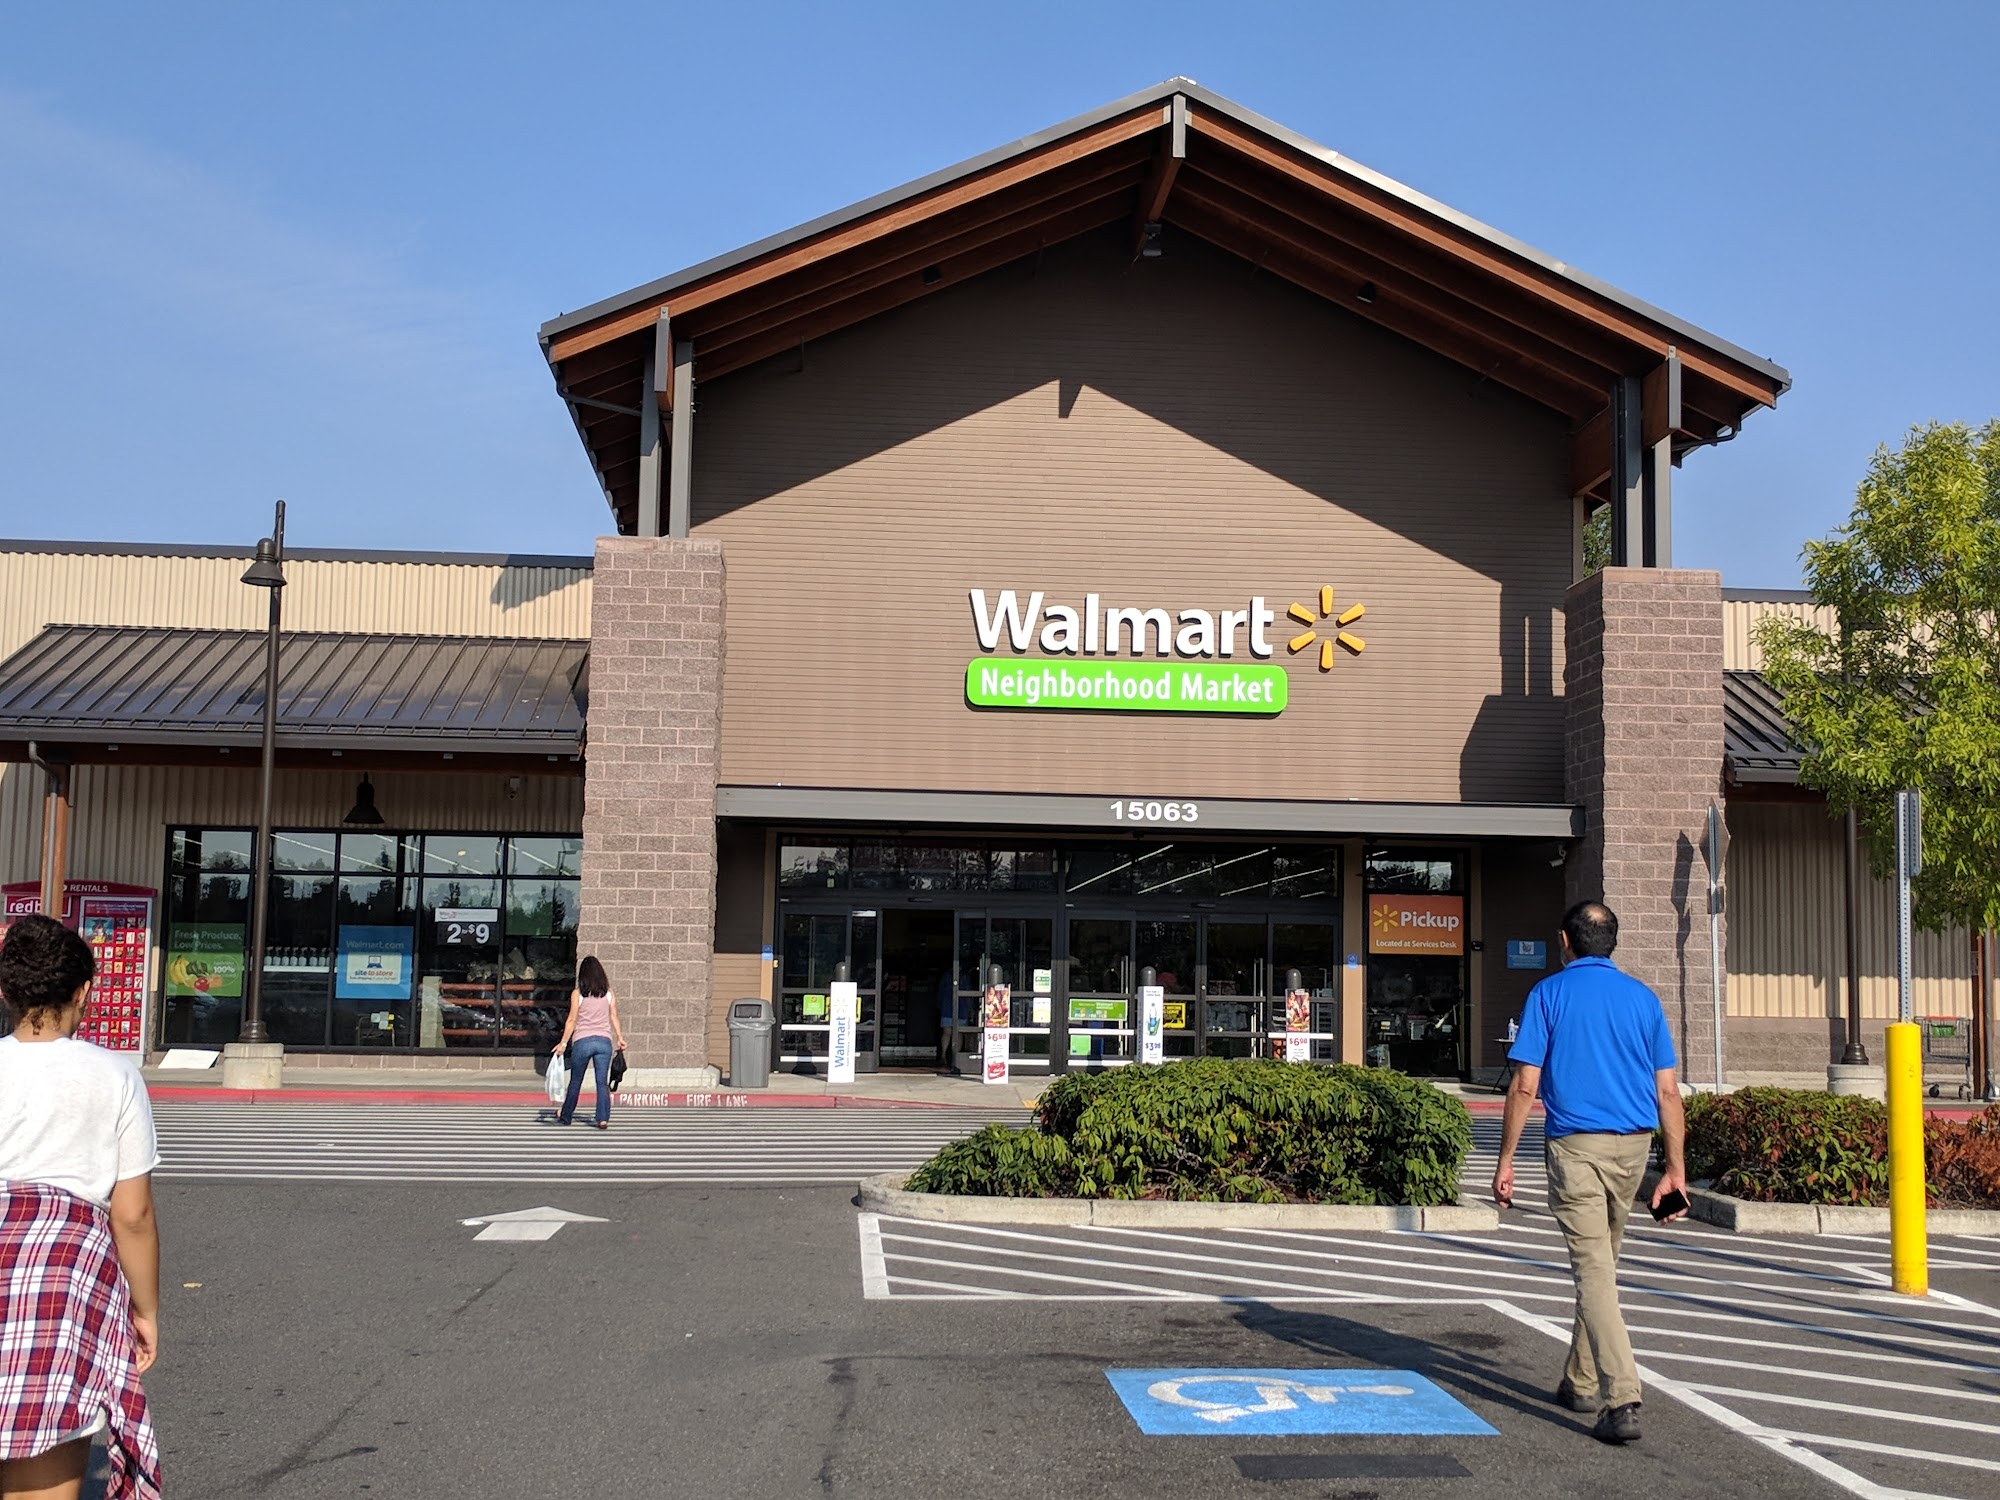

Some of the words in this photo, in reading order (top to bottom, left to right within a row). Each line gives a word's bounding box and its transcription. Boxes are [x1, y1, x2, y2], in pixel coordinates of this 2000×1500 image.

[969, 588, 1275, 656] Walmart
[980, 667, 1171, 704] Neighborhood
[1181, 672, 1273, 703] Market
[1110, 800, 1199, 822] 15063
[70, 884, 108, 893] RENTALS
[9, 900, 41, 913] redb
[1400, 911, 1460, 932] Pickup
[446, 923, 462, 943] 2
[173, 941, 193, 949] Low
[345, 940, 405, 949] Walmart.com
[1376, 939, 1402, 947] Located
[1403, 940, 1411, 948] at
[1411, 940, 1439, 948] Services
[213, 965, 235, 973] 100%
[834, 1016, 846, 1068] Walmart
[619, 1093, 669, 1107] PARKING
[686, 1094, 712, 1107] FIRE
